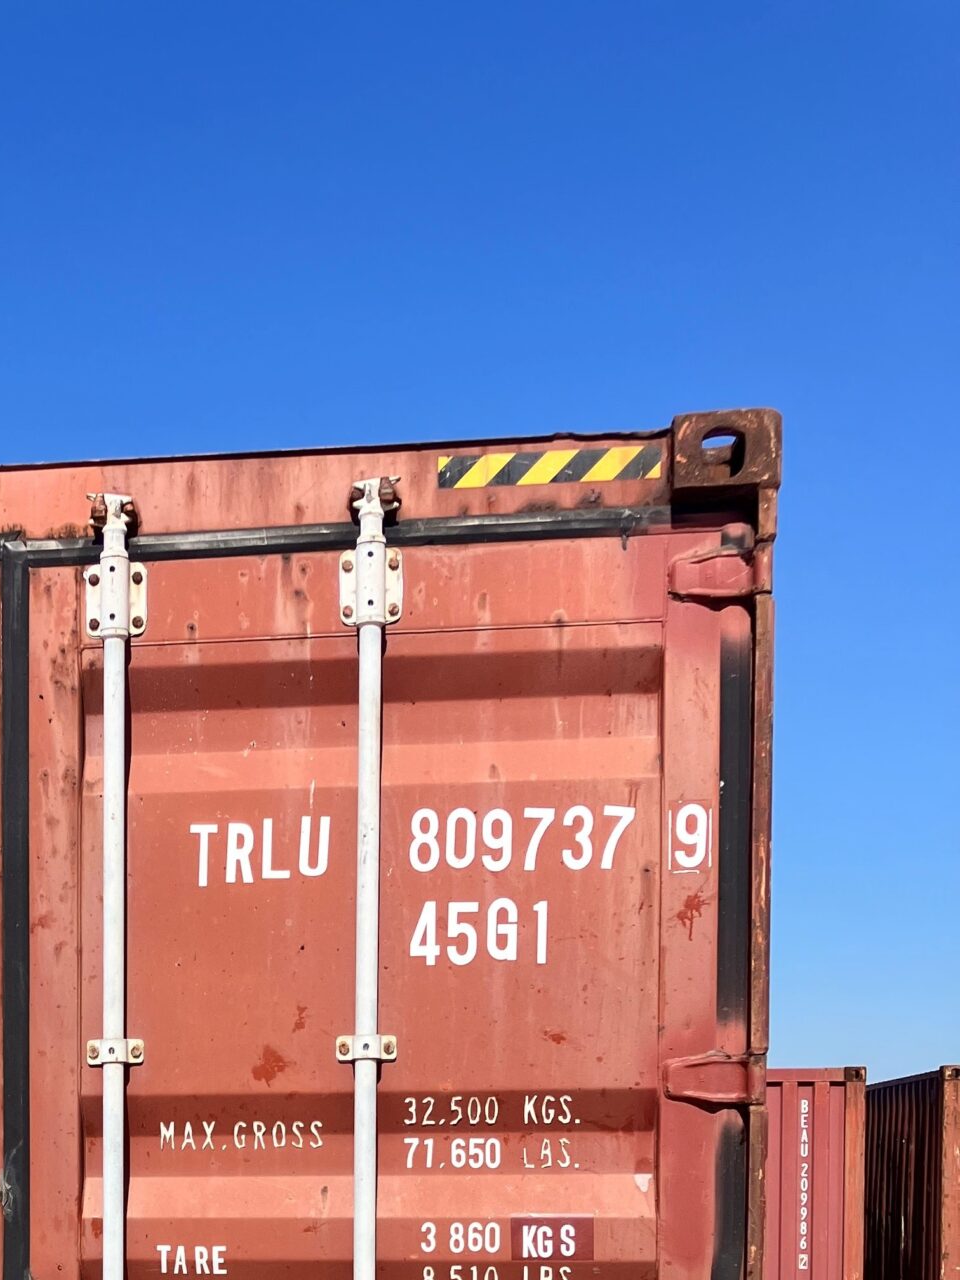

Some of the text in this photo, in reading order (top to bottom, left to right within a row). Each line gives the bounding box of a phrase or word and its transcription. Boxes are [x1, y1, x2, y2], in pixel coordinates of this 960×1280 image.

[189, 803, 708, 887] TRLU 809737 9
[409, 897, 548, 966] 45G1
[404, 1095, 580, 1125] 32,500 KGS.
[799, 1099, 809, 1158] BEAU
[403, 1137, 501, 1169] 71,650
[798, 1162, 809, 1250] 209986
[156, 1244, 227, 1275] TARE
